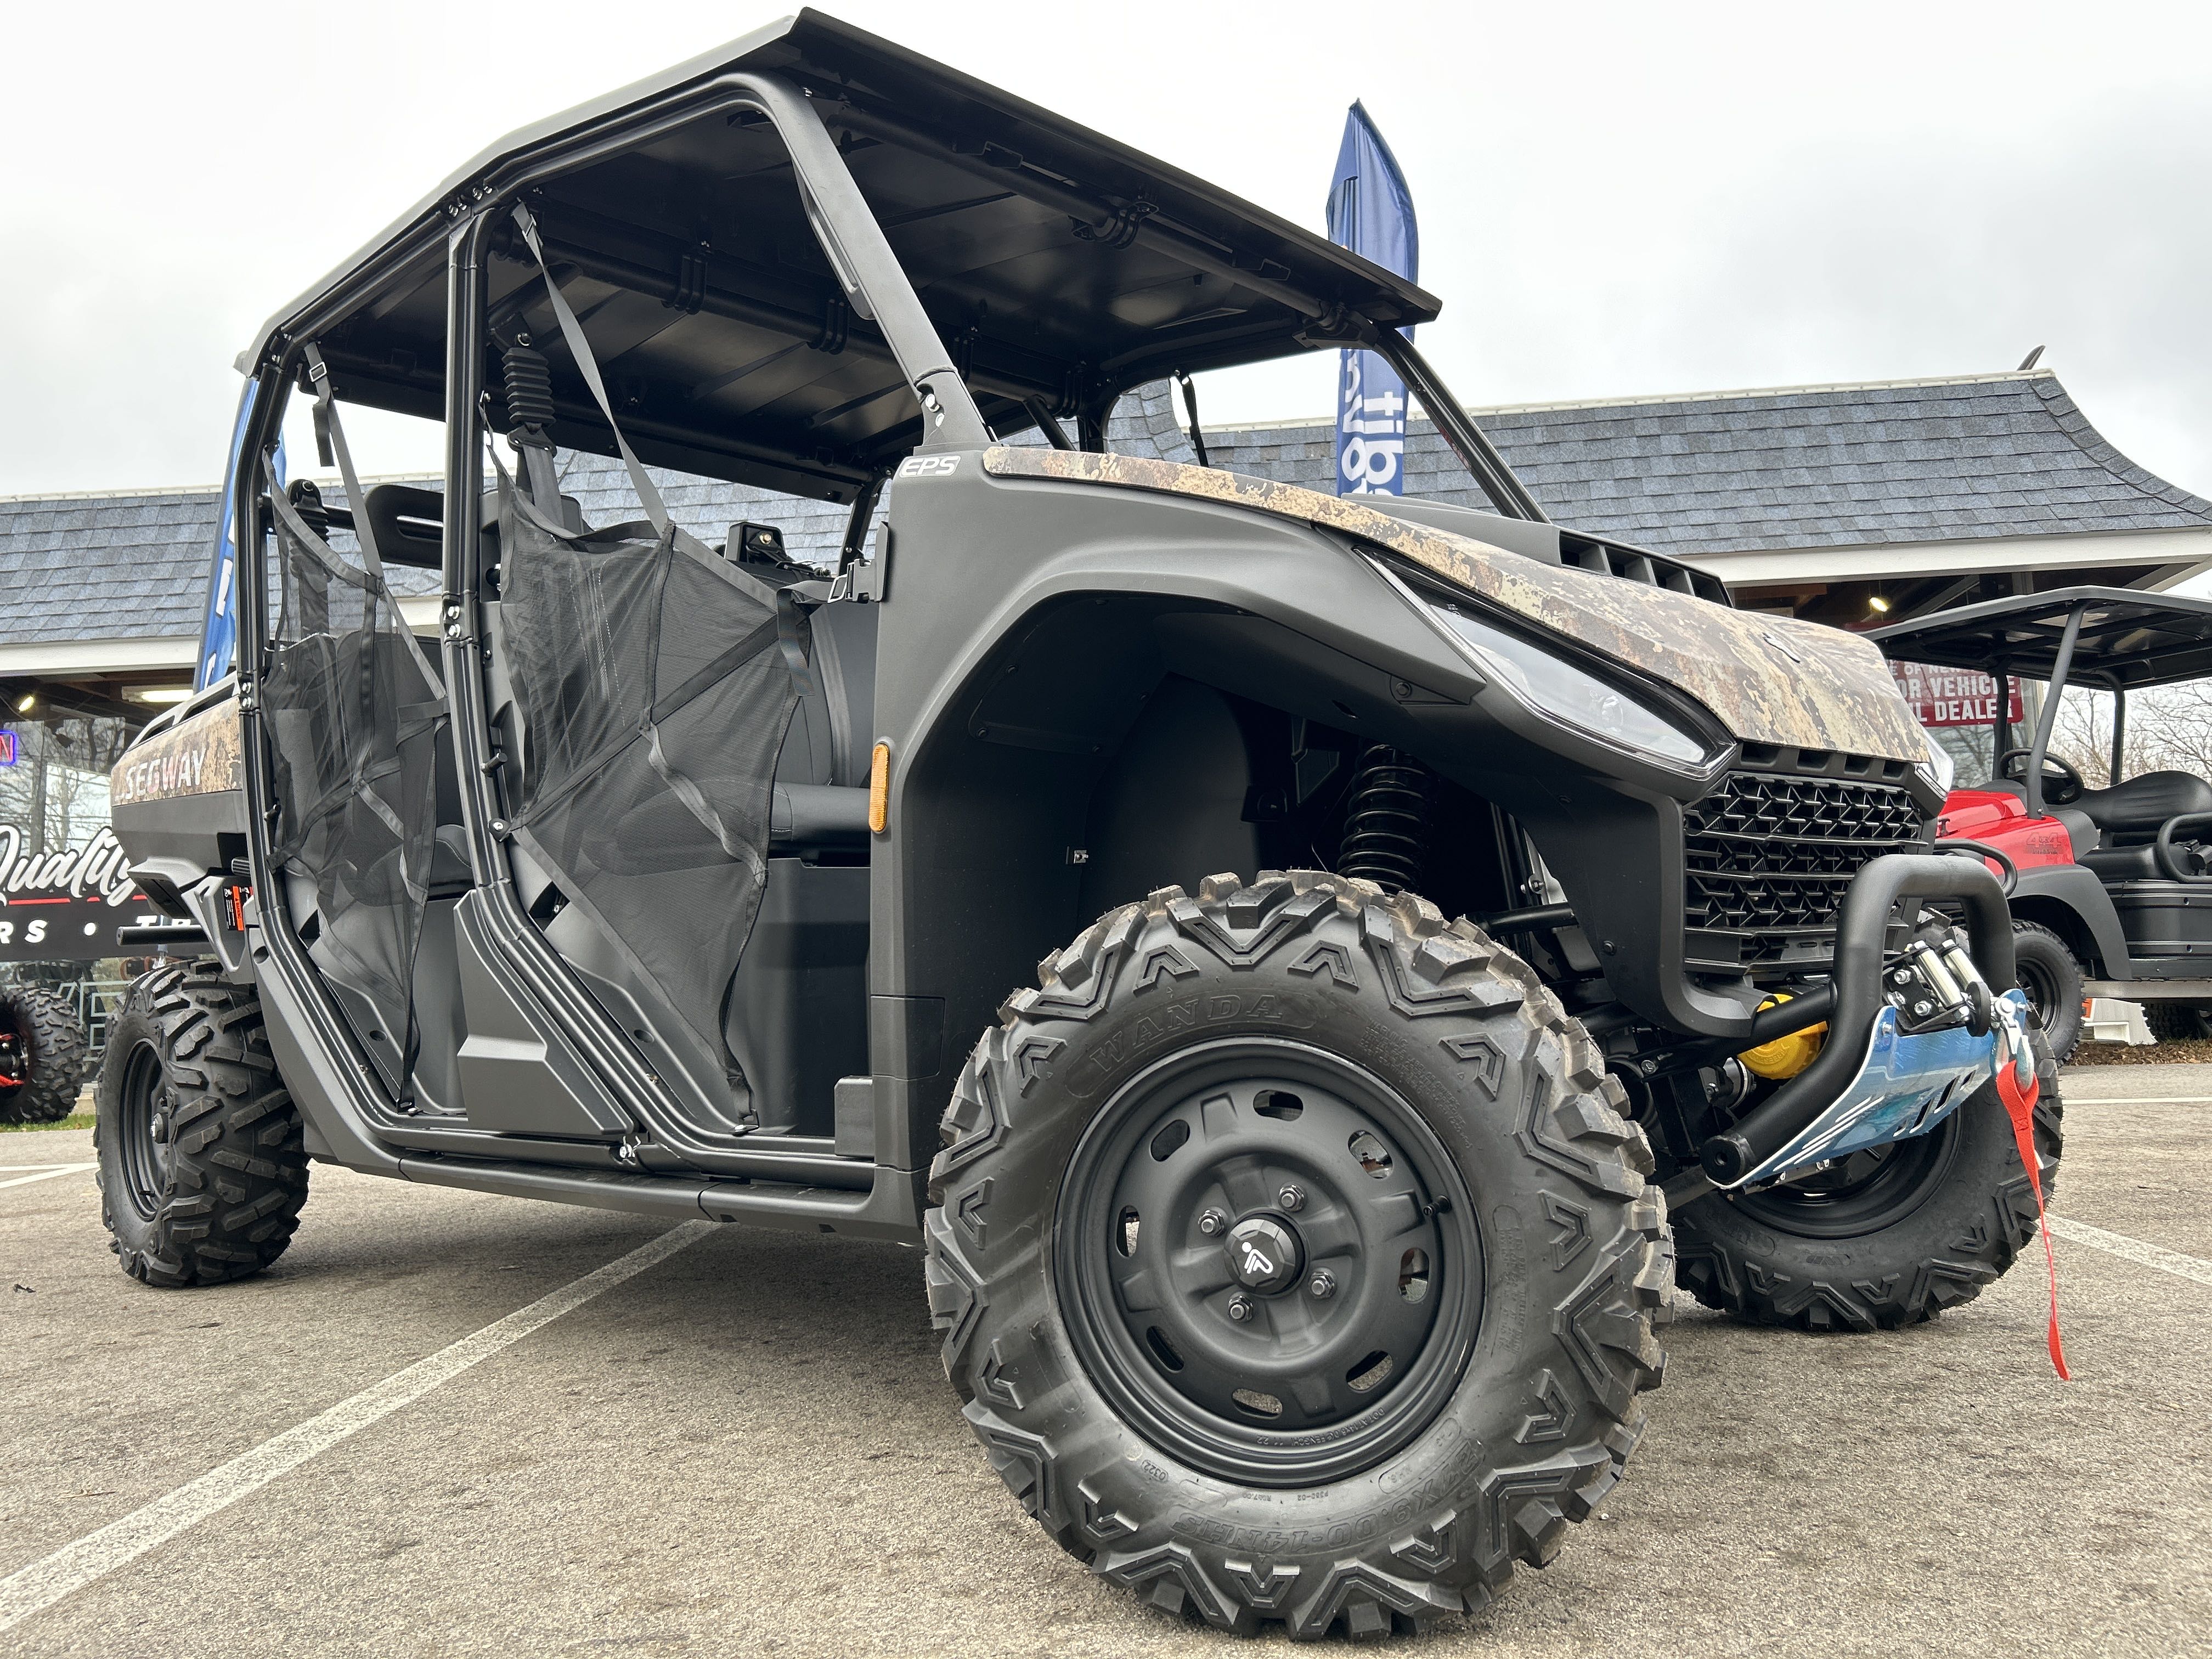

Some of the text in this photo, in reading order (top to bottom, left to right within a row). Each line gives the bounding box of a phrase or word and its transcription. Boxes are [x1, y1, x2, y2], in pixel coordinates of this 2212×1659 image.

[900, 456, 960, 476] EPS
[126, 748, 207, 800] SEGWAY
[1090, 994, 1283, 1073] WANDA
[1143, 1462, 1167, 1482] 0322
